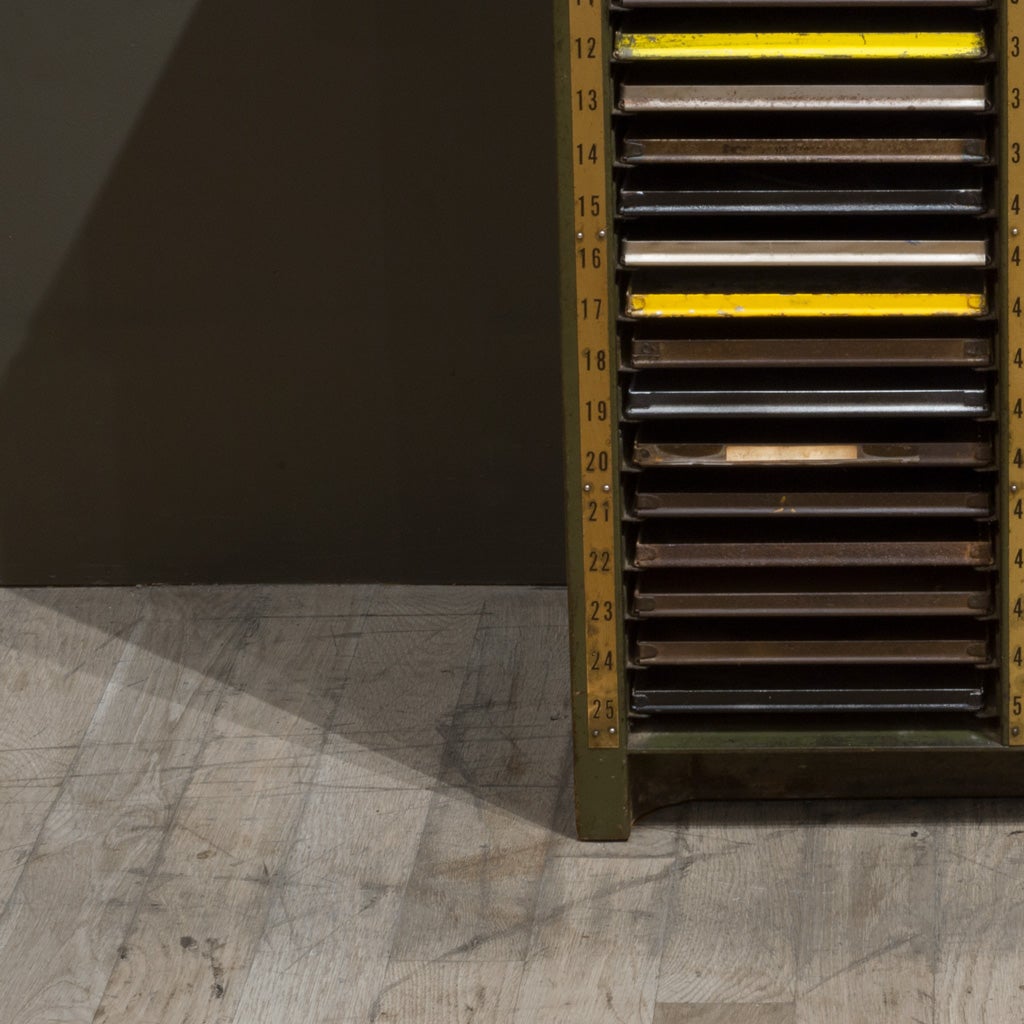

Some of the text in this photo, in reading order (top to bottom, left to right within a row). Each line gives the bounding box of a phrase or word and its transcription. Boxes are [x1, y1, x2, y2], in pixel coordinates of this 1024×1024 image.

[575, 37, 597, 59] 12
[576, 89, 598, 111] 13
[576, 144, 598, 165] 14
[578, 195, 600, 217] 15
[579, 248, 601, 269] 16
[581, 299, 602, 320] 17
[584, 350, 606, 371] 18
[585, 400, 607, 422] 19
[586, 451, 608, 472] 20
[588, 501, 610, 522] 21
[589, 551, 610, 572] 22
[591, 601, 612, 621] 23
[591, 650, 613, 670] 24
[593, 699, 614, 720] 25
